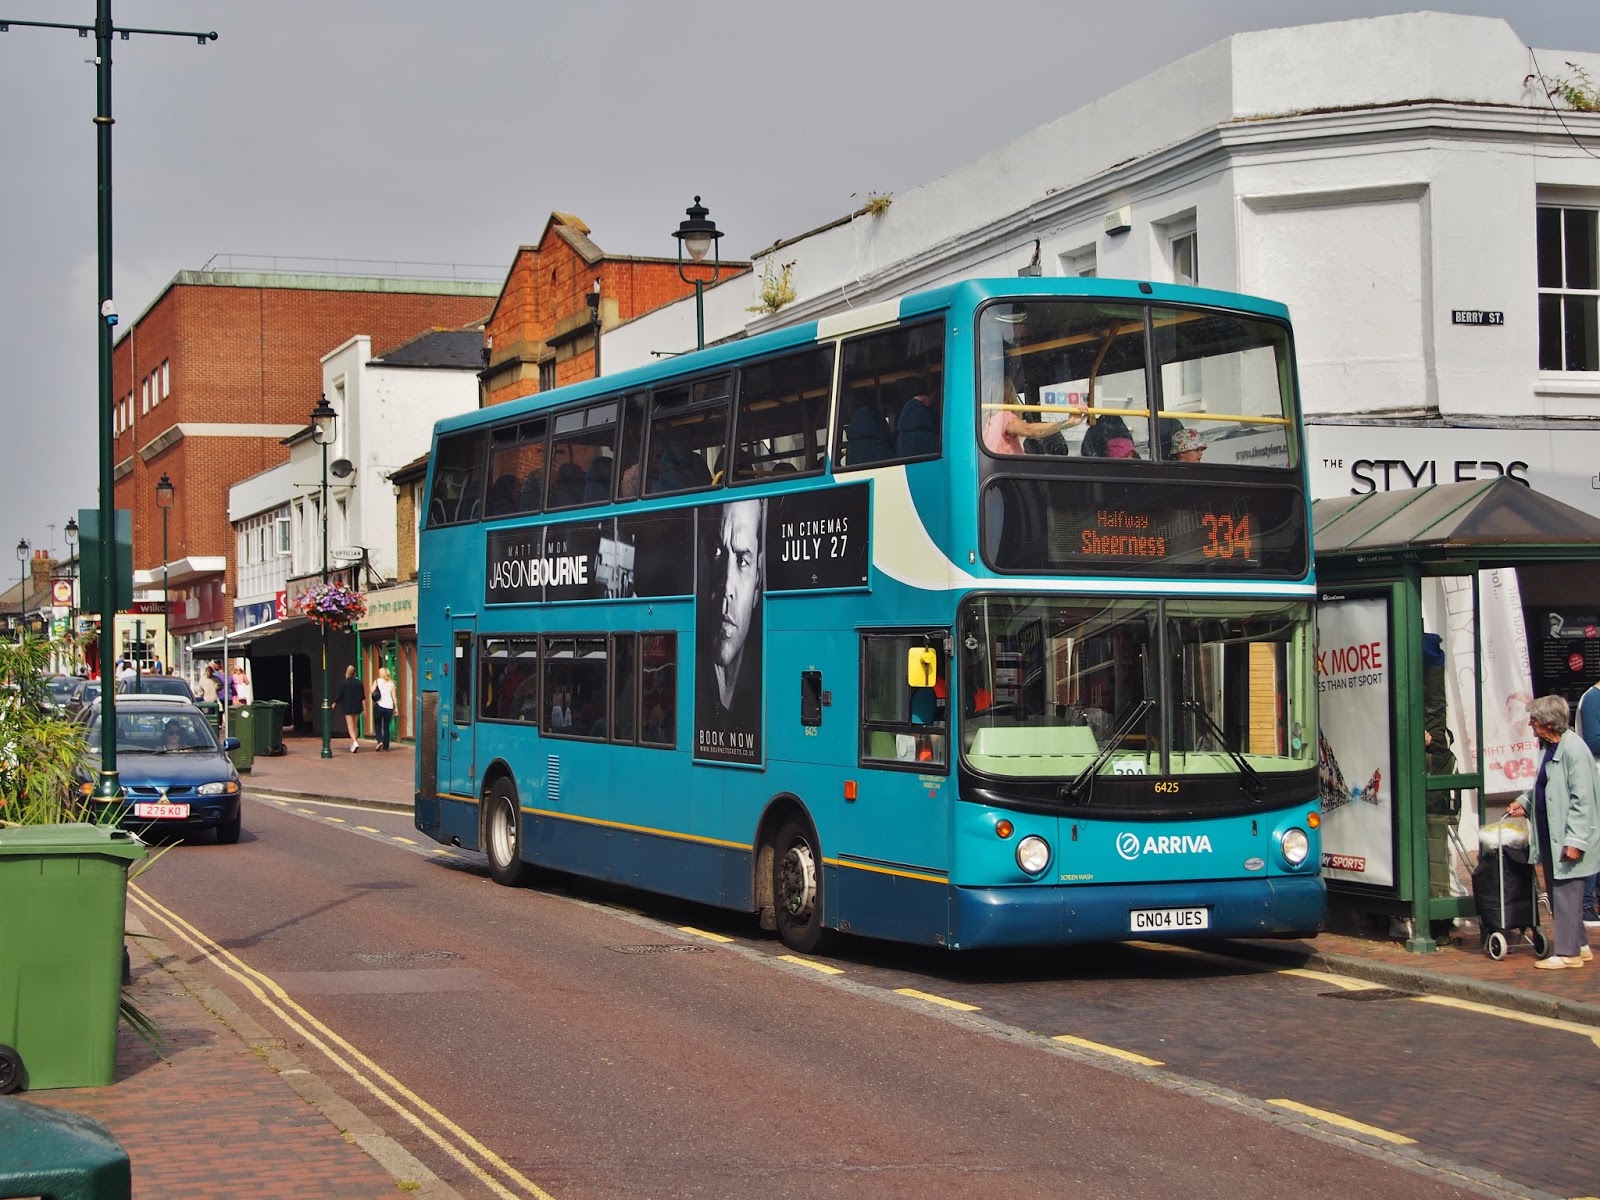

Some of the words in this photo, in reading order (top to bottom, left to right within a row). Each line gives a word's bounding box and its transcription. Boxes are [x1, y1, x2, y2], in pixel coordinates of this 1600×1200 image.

[1455, 311, 1483, 323] BERRY
[1488, 312, 1503, 324] ST.
[1323, 459, 1343, 469] THE
[782, 523, 793, 538] IN
[799, 517, 848, 536] CINEMAS
[1097, 510, 1148, 528] Halfway
[1081, 530, 1165, 556] Sheerness
[1202, 514, 1252, 559] 334
[508, 544, 531, 557] MATT
[537, 541, 568, 555] DMON
[782, 537, 821, 562] JULY
[831, 535, 848, 558] 27
[1332, 641, 1382, 675] MORE
[1327, 678, 1347, 691] THAN
[1348, 676, 1357, 688] BT
[1358, 673, 1382, 687] SPORT
[700, 730, 725, 746] BOOK
[730, 732, 754, 749] NOW
[805, 726, 818, 737] 6425
[1154, 782, 1179, 793] 6425
[147, 806, 166, 815] 275
[1143, 835, 1212, 854] ARRIVA
[1322, 853, 1331, 866] ky
[1332, 856, 1364, 870] SPORTS
[1136, 912, 1171, 928] GN04
[1176, 911, 1202, 926] UES
